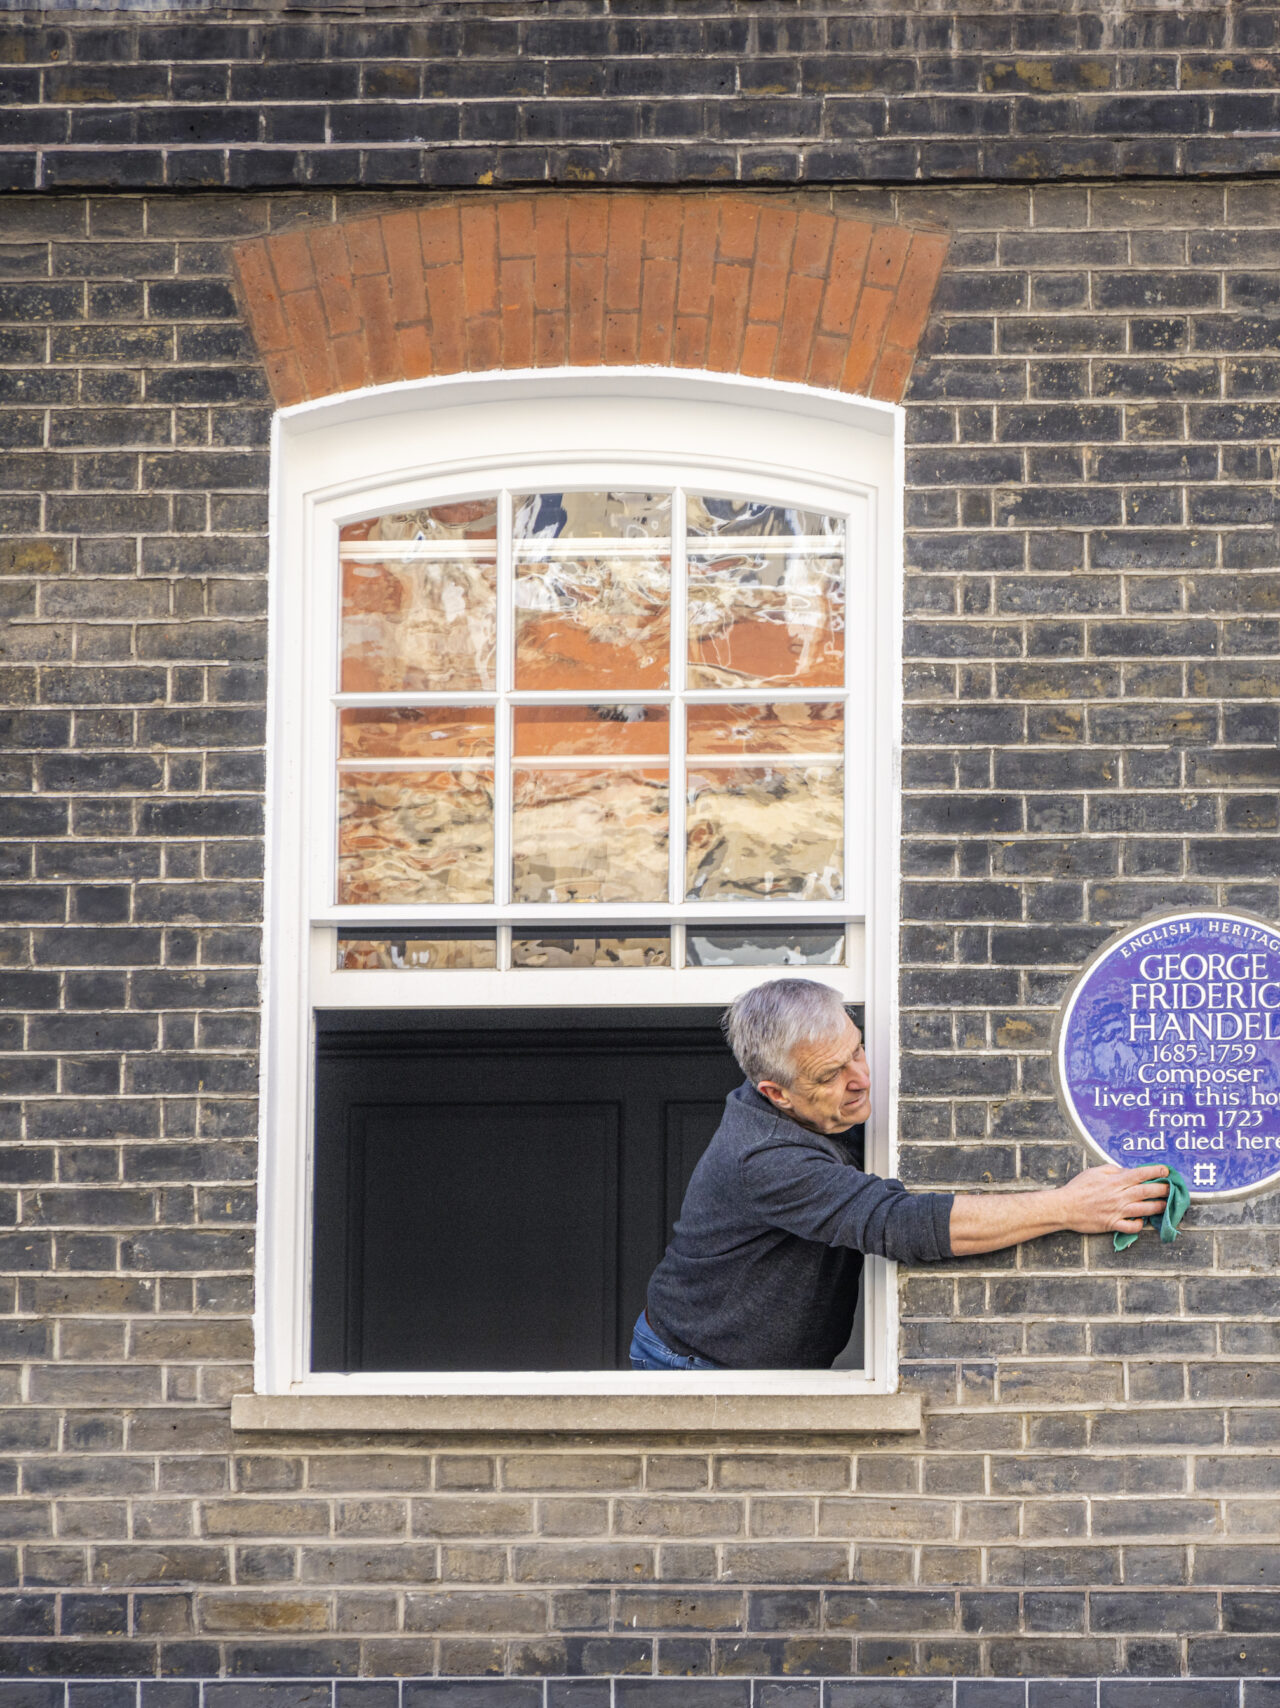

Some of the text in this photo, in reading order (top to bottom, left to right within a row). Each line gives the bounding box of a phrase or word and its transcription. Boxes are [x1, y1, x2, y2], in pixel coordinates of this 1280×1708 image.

[1120, 922, 1191, 958] ENGLISH
[1140, 954, 1269, 981] GEORGE
[1131, 982, 1280, 1009] FRIDERIC
[1153, 1044, 1256, 1063] 1685-1759
[1138, 1064, 1264, 1088] Composer
[1094, 1088, 1150, 1106] lived
[1162, 1089, 1184, 1106] in
[1195, 1087, 1240, 1105] this
[1149, 1109, 1262, 1127] from 1723
[1123, 1132, 1165, 1150] and
[1176, 1131, 1224, 1150] died
